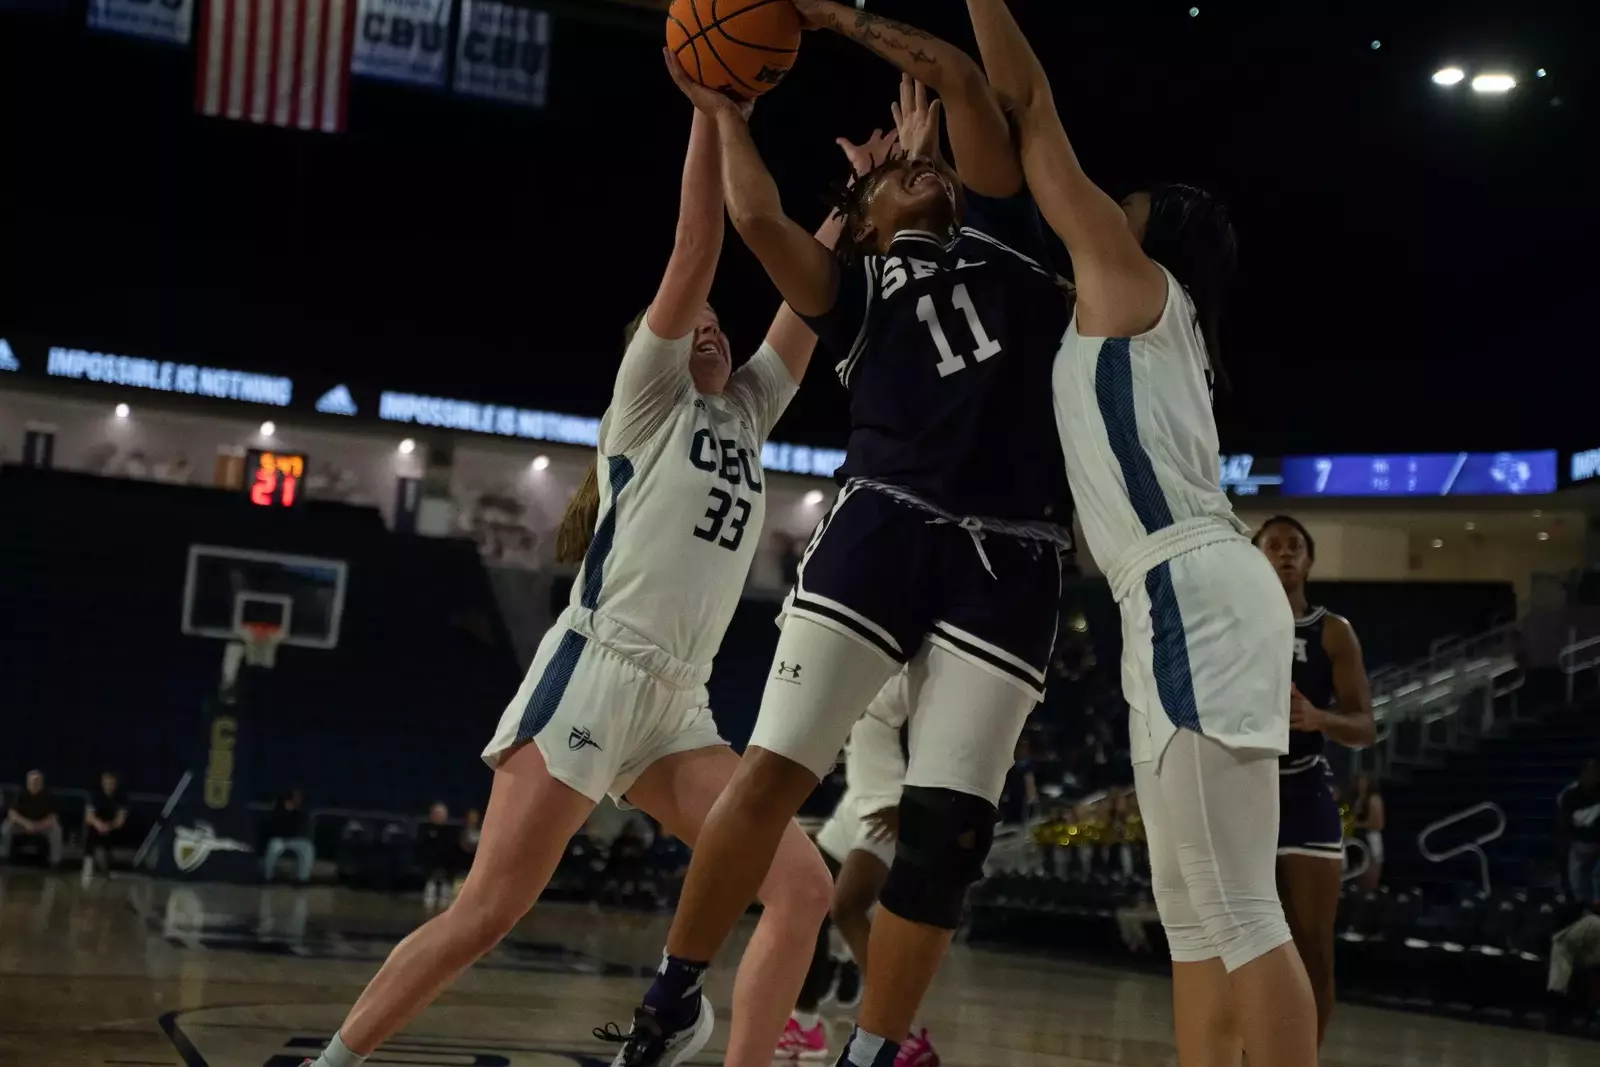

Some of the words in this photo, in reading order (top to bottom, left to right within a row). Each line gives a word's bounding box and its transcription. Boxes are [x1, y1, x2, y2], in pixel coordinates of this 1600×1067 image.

[881, 256, 987, 300] SF
[916, 282, 1002, 378] 11
[47, 346, 174, 391] IMPOSSIBLE
[175, 364, 198, 394] IS
[199, 367, 293, 406] NOTHING
[379, 390, 494, 434] IMPOSSIBLE
[496, 405, 516, 436] IS
[250, 468, 296, 507] 21
[1315, 459, 1333, 492] 7
[693, 486, 752, 552] 33
